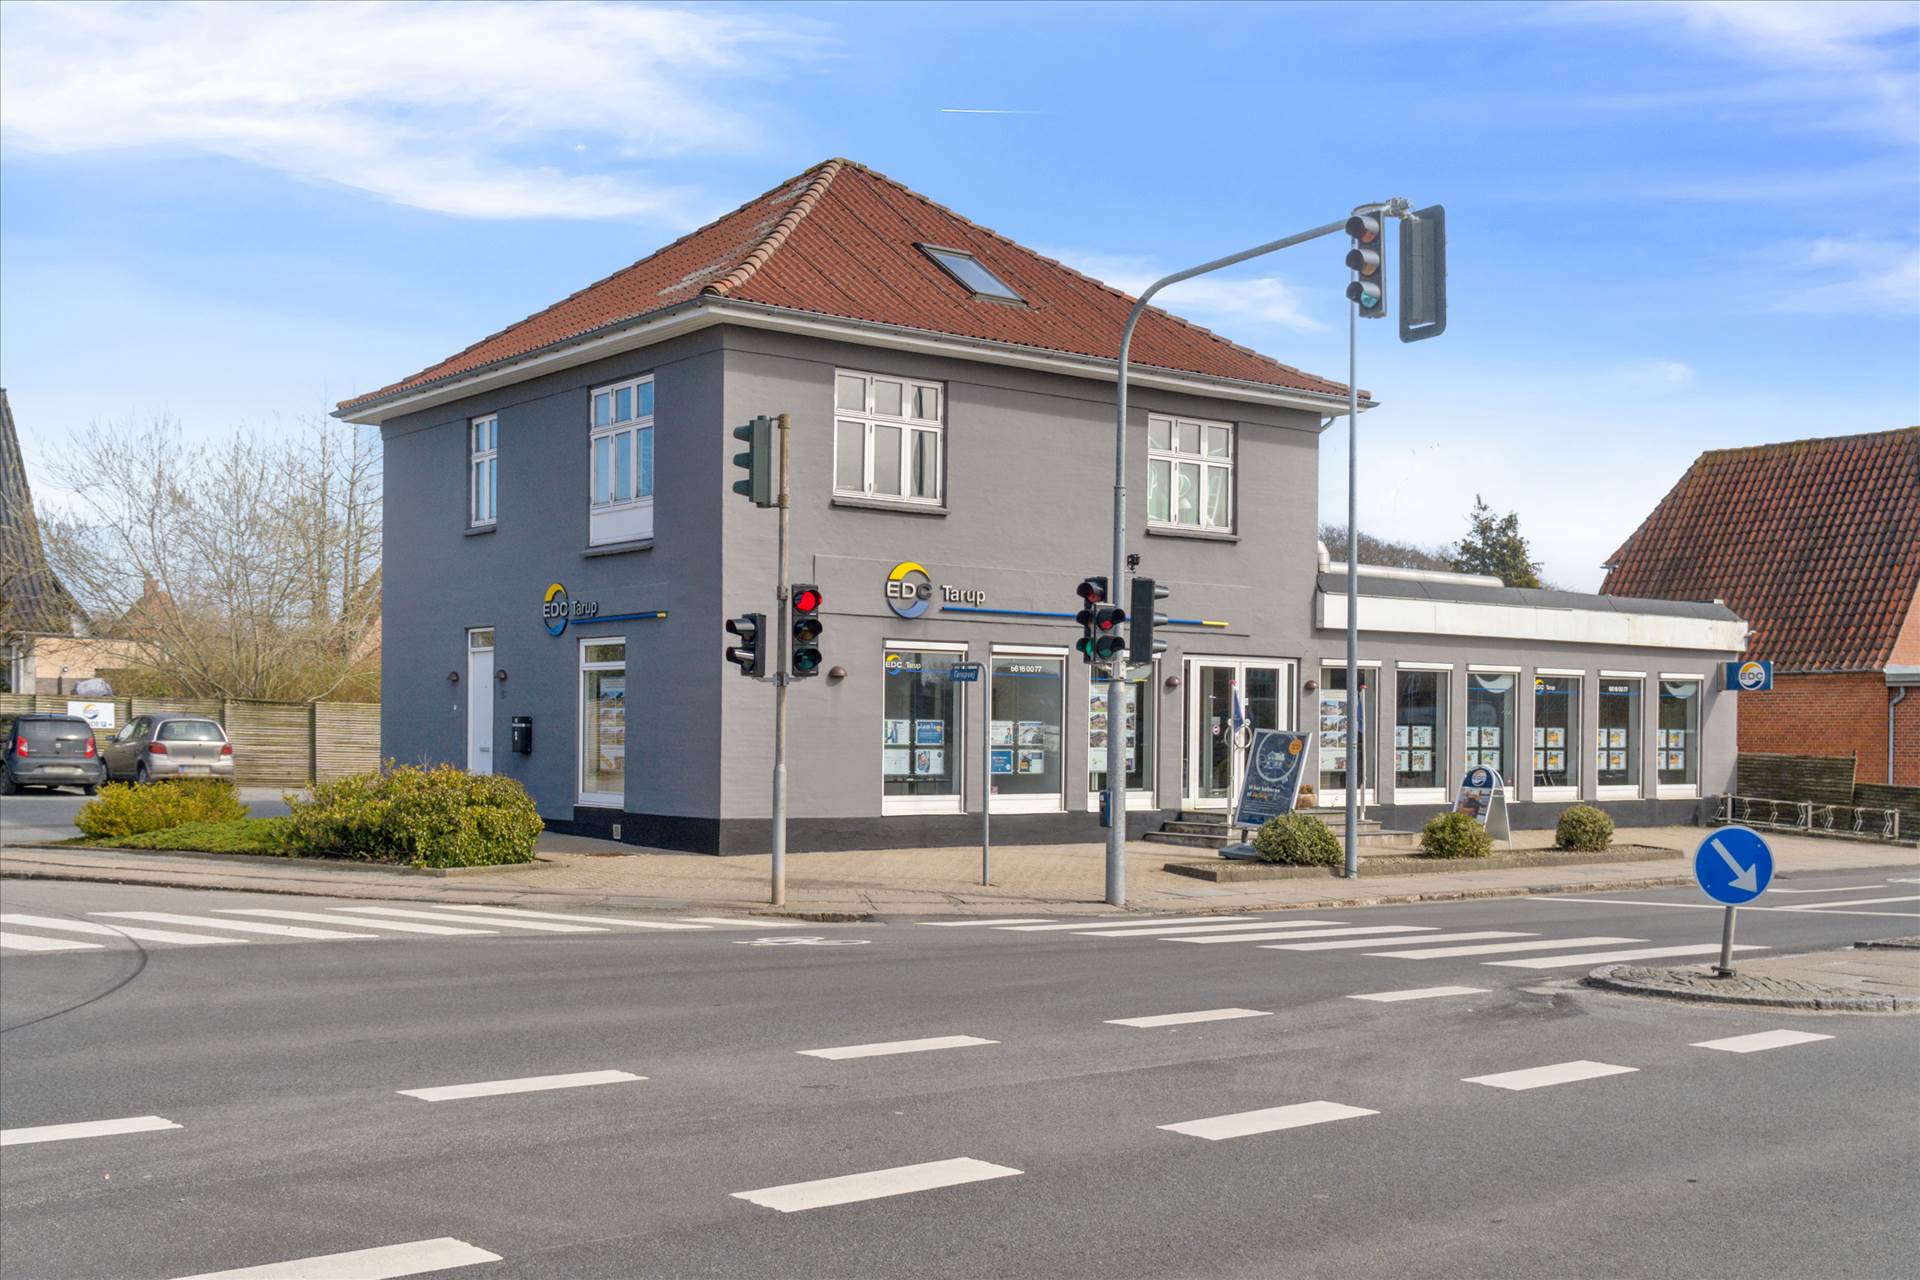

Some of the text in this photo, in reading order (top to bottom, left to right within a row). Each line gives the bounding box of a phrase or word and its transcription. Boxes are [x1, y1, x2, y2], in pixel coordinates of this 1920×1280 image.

[886, 581, 986, 605] EDC Tarup
[543, 600, 598, 618] EDC Tarup
[885, 661, 902, 669] EDC
[1740, 671, 1764, 681] EDC
